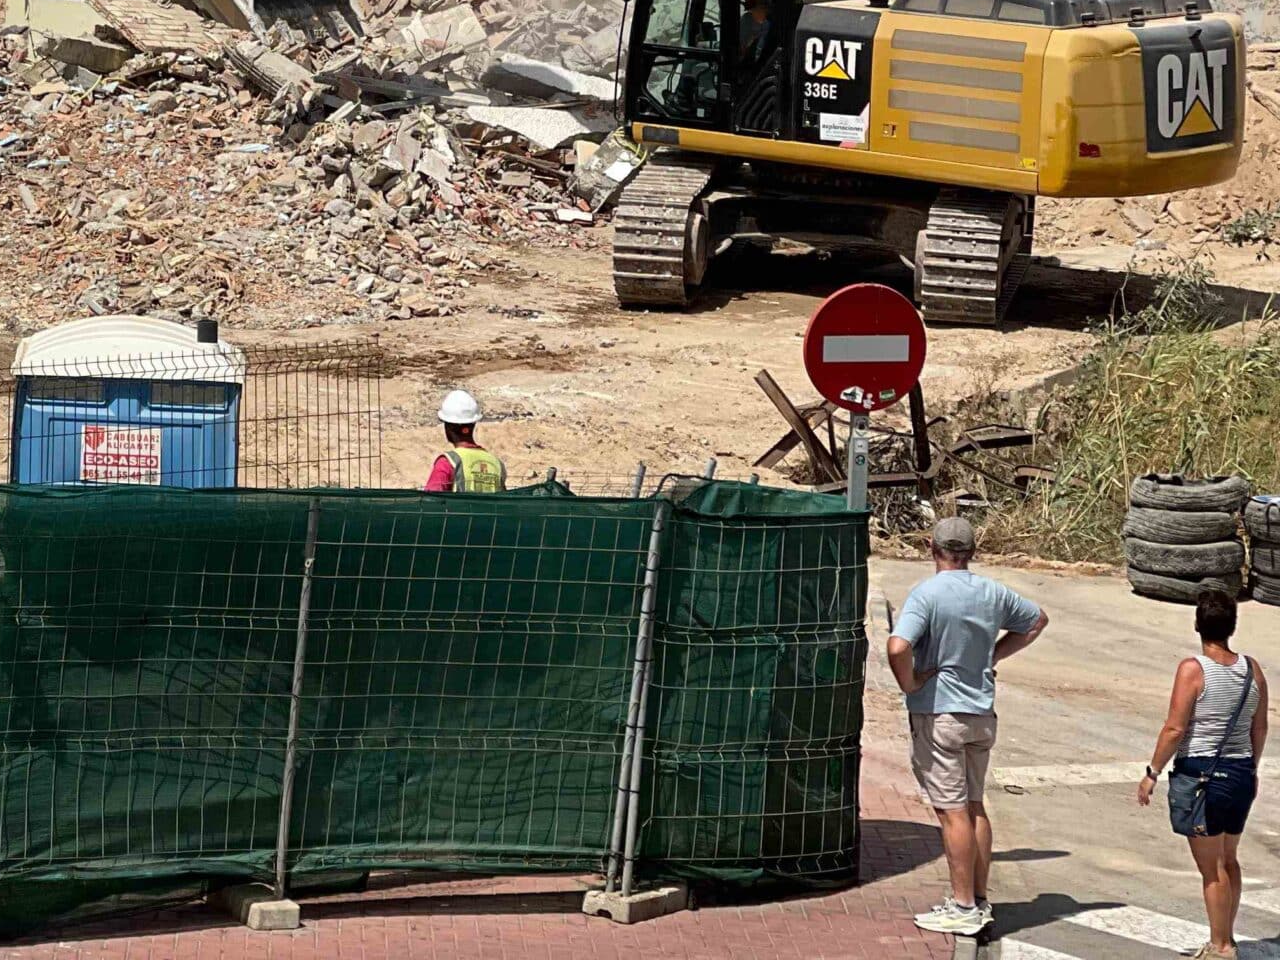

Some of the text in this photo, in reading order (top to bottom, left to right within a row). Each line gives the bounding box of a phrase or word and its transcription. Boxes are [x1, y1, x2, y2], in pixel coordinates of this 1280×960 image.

[804, 37, 862, 80] CAT
[804, 82, 838, 99] 336E
[1157, 48, 1228, 138] CAT
[107, 442, 156, 450] ALICANTE
[86, 454, 157, 467] ECO-ASEO
